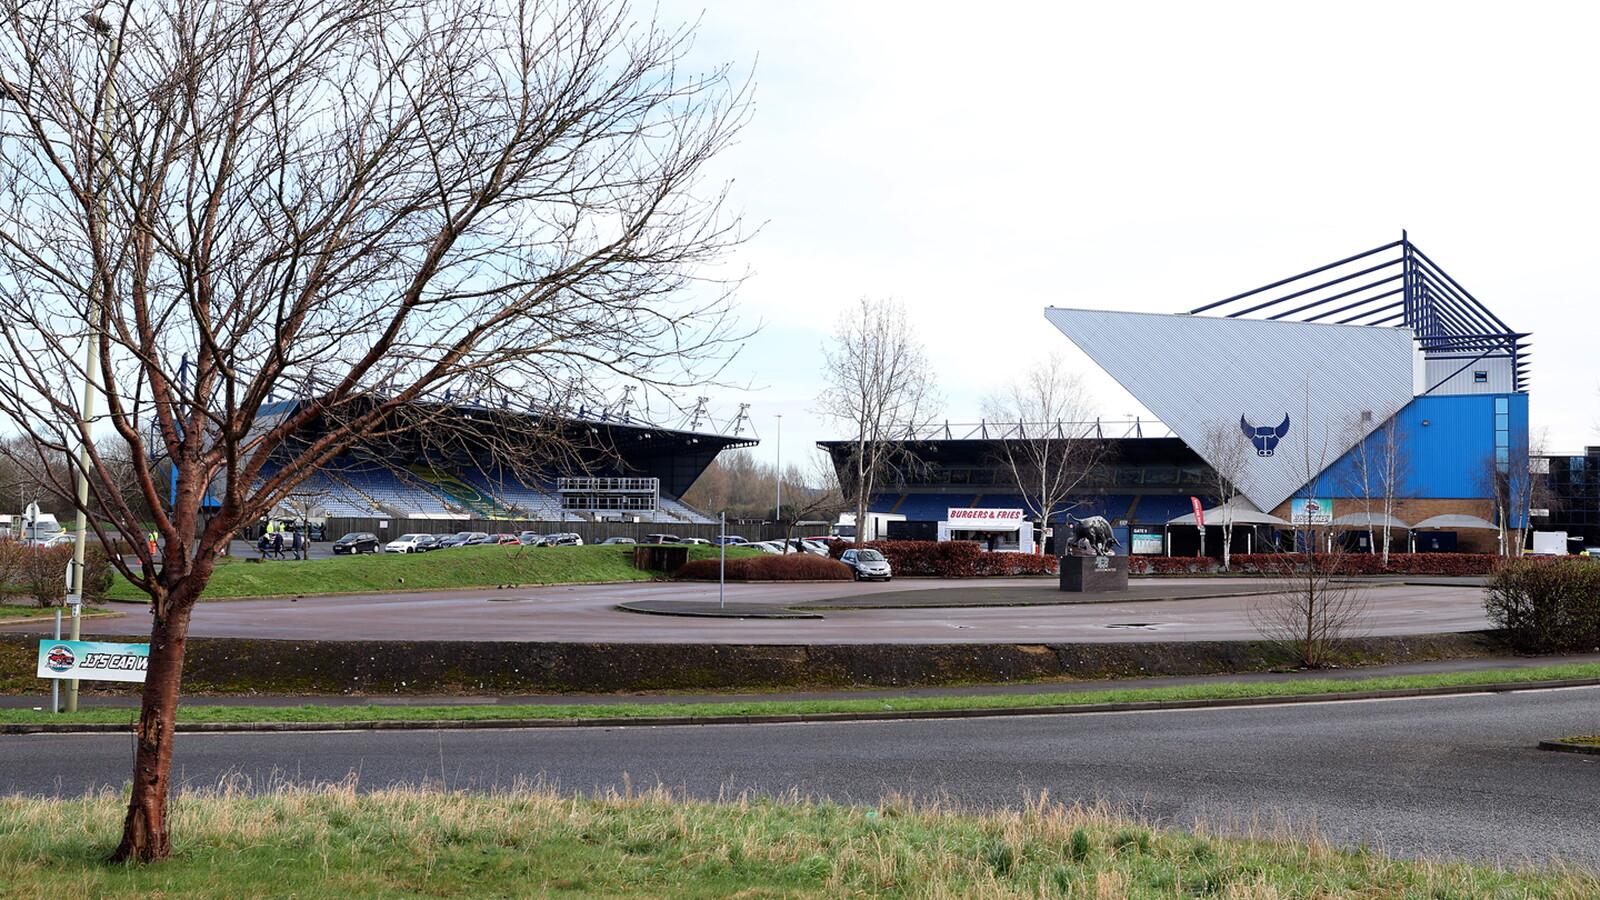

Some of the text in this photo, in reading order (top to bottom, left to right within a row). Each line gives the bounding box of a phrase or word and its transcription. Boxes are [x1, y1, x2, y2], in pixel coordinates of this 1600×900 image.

[950, 510, 1021, 519] BURGERS & FRIES
[108, 654, 137, 670] CAR
